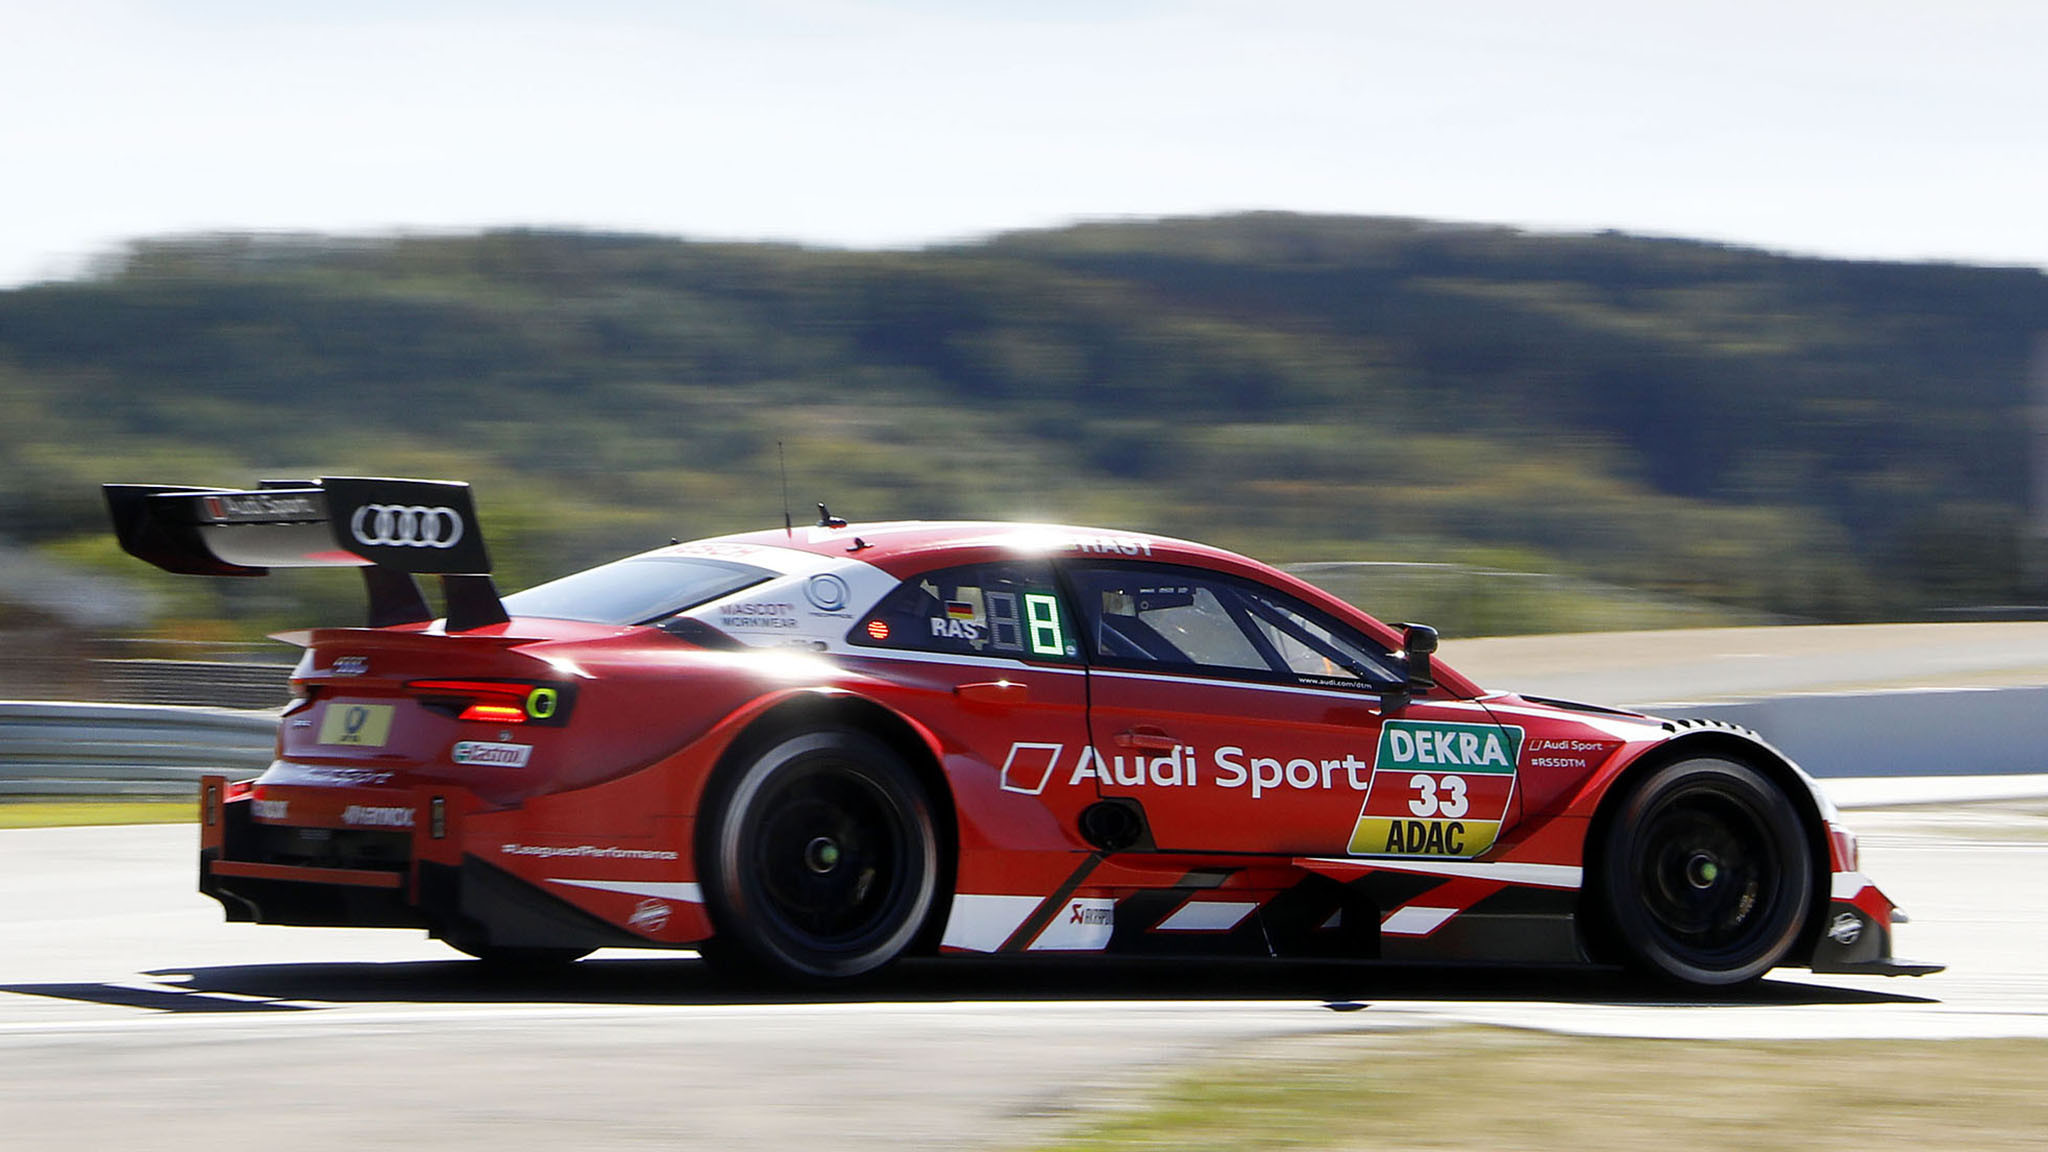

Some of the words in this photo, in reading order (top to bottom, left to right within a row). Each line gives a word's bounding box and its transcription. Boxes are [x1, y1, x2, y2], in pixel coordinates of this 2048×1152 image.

[1298, 677, 1373, 690] www.audi.com/dtm
[1389, 729, 1509, 767] DEKRA
[1531, 757, 1586, 768] #RS5DTM
[1543, 740, 1568, 750] Audi
[1571, 740, 1603, 752] Sport
[1069, 745, 1197, 787] Audi
[1214, 746, 1368, 799] Sport
[1408, 773, 1469, 819] 33
[1385, 820, 1465, 855] ADAC
